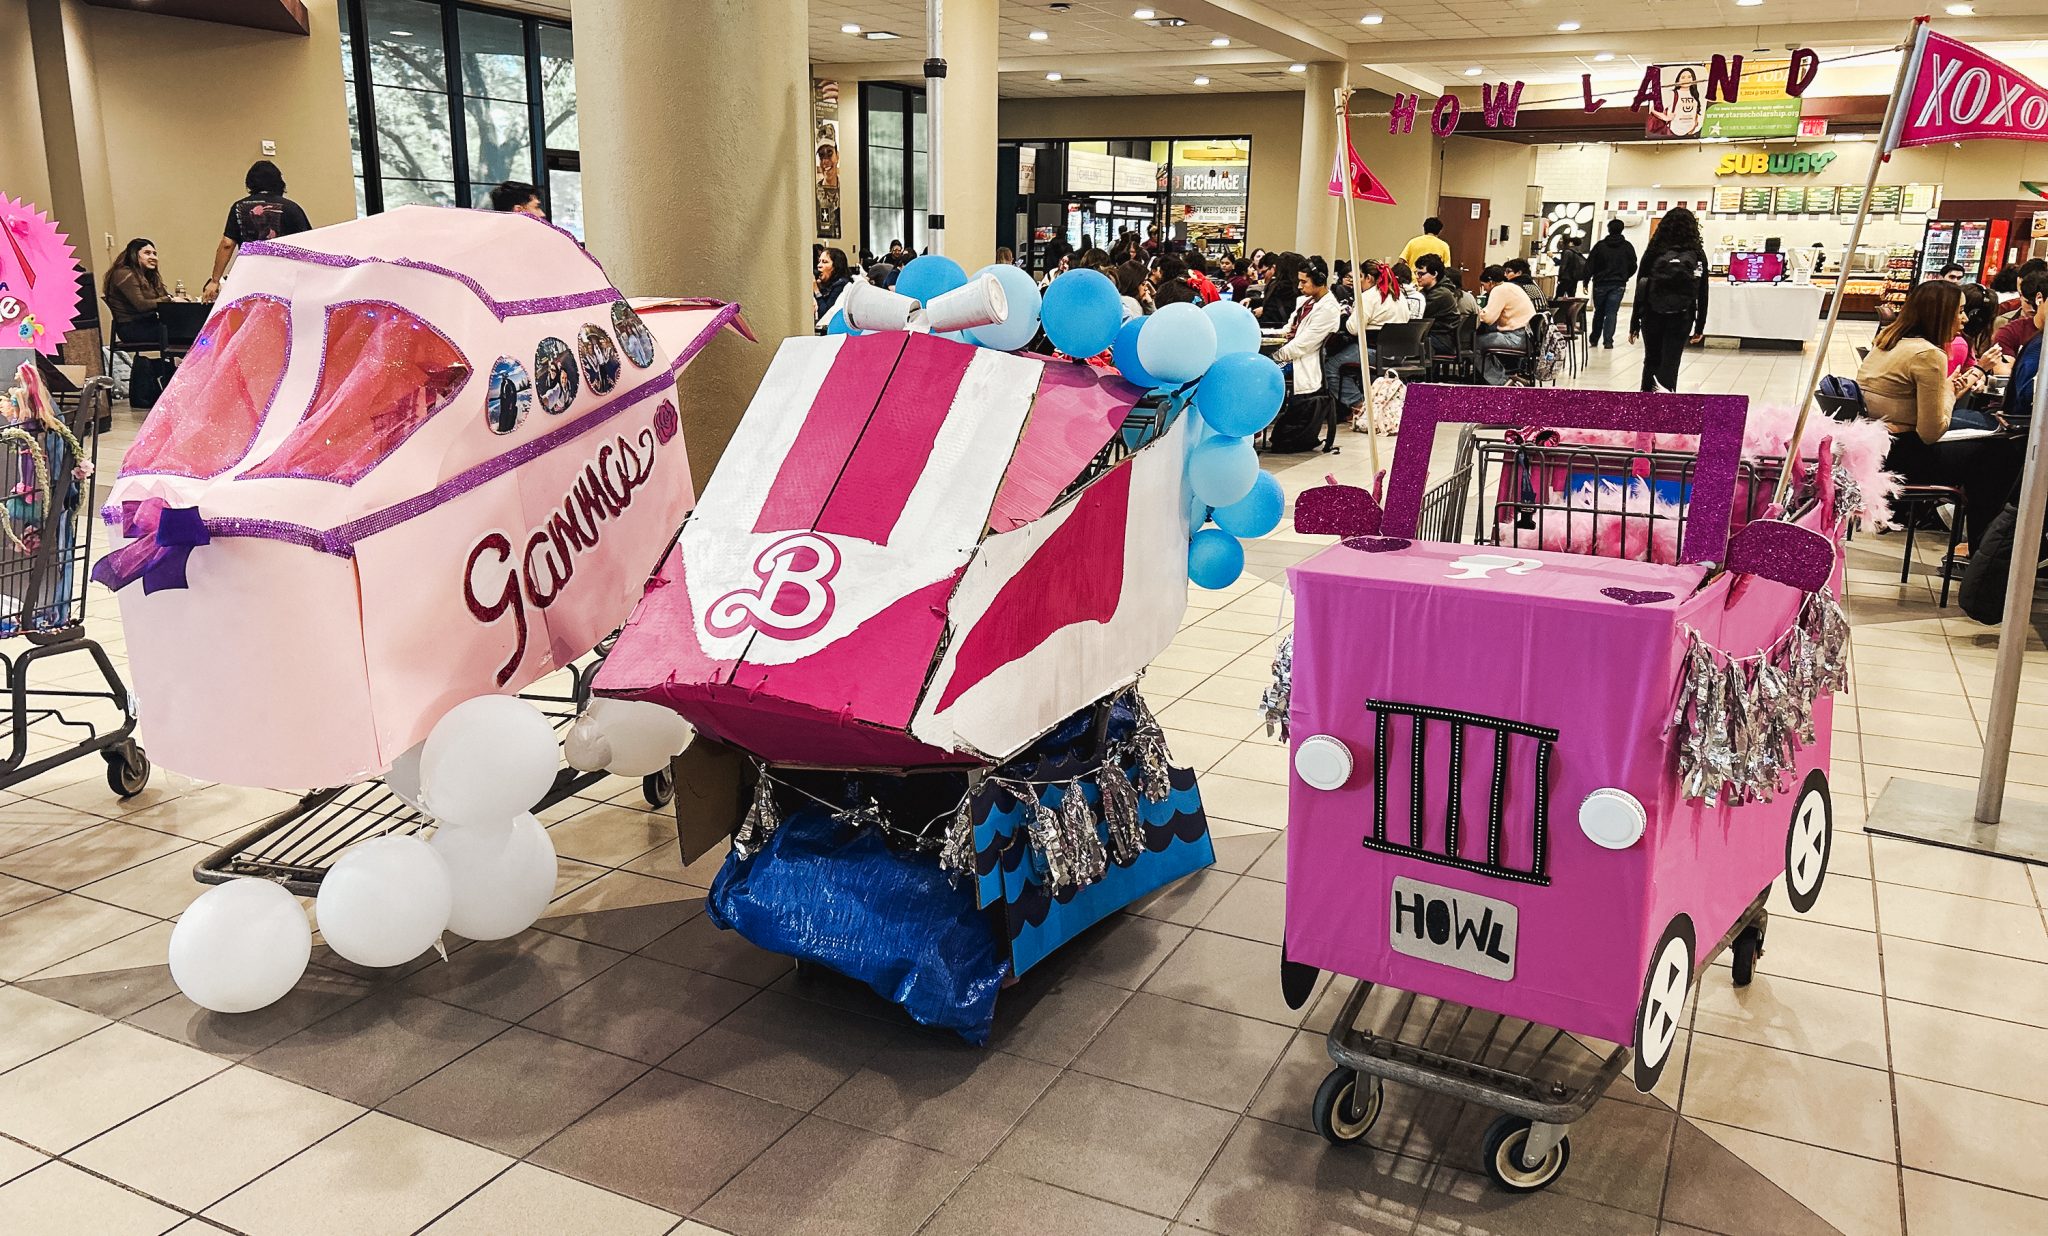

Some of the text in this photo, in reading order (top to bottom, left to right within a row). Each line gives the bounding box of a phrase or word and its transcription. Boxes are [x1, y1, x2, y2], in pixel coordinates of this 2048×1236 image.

[1914, 53, 2048, 131] XOXO
[1183, 174, 1239, 190] RECHARGE
[1714, 151, 1837, 176] SUBWAY
[1219, 206, 1238, 214] COFFEE
[704, 532, 841, 641] B
[1395, 890, 1510, 964] HOWL
